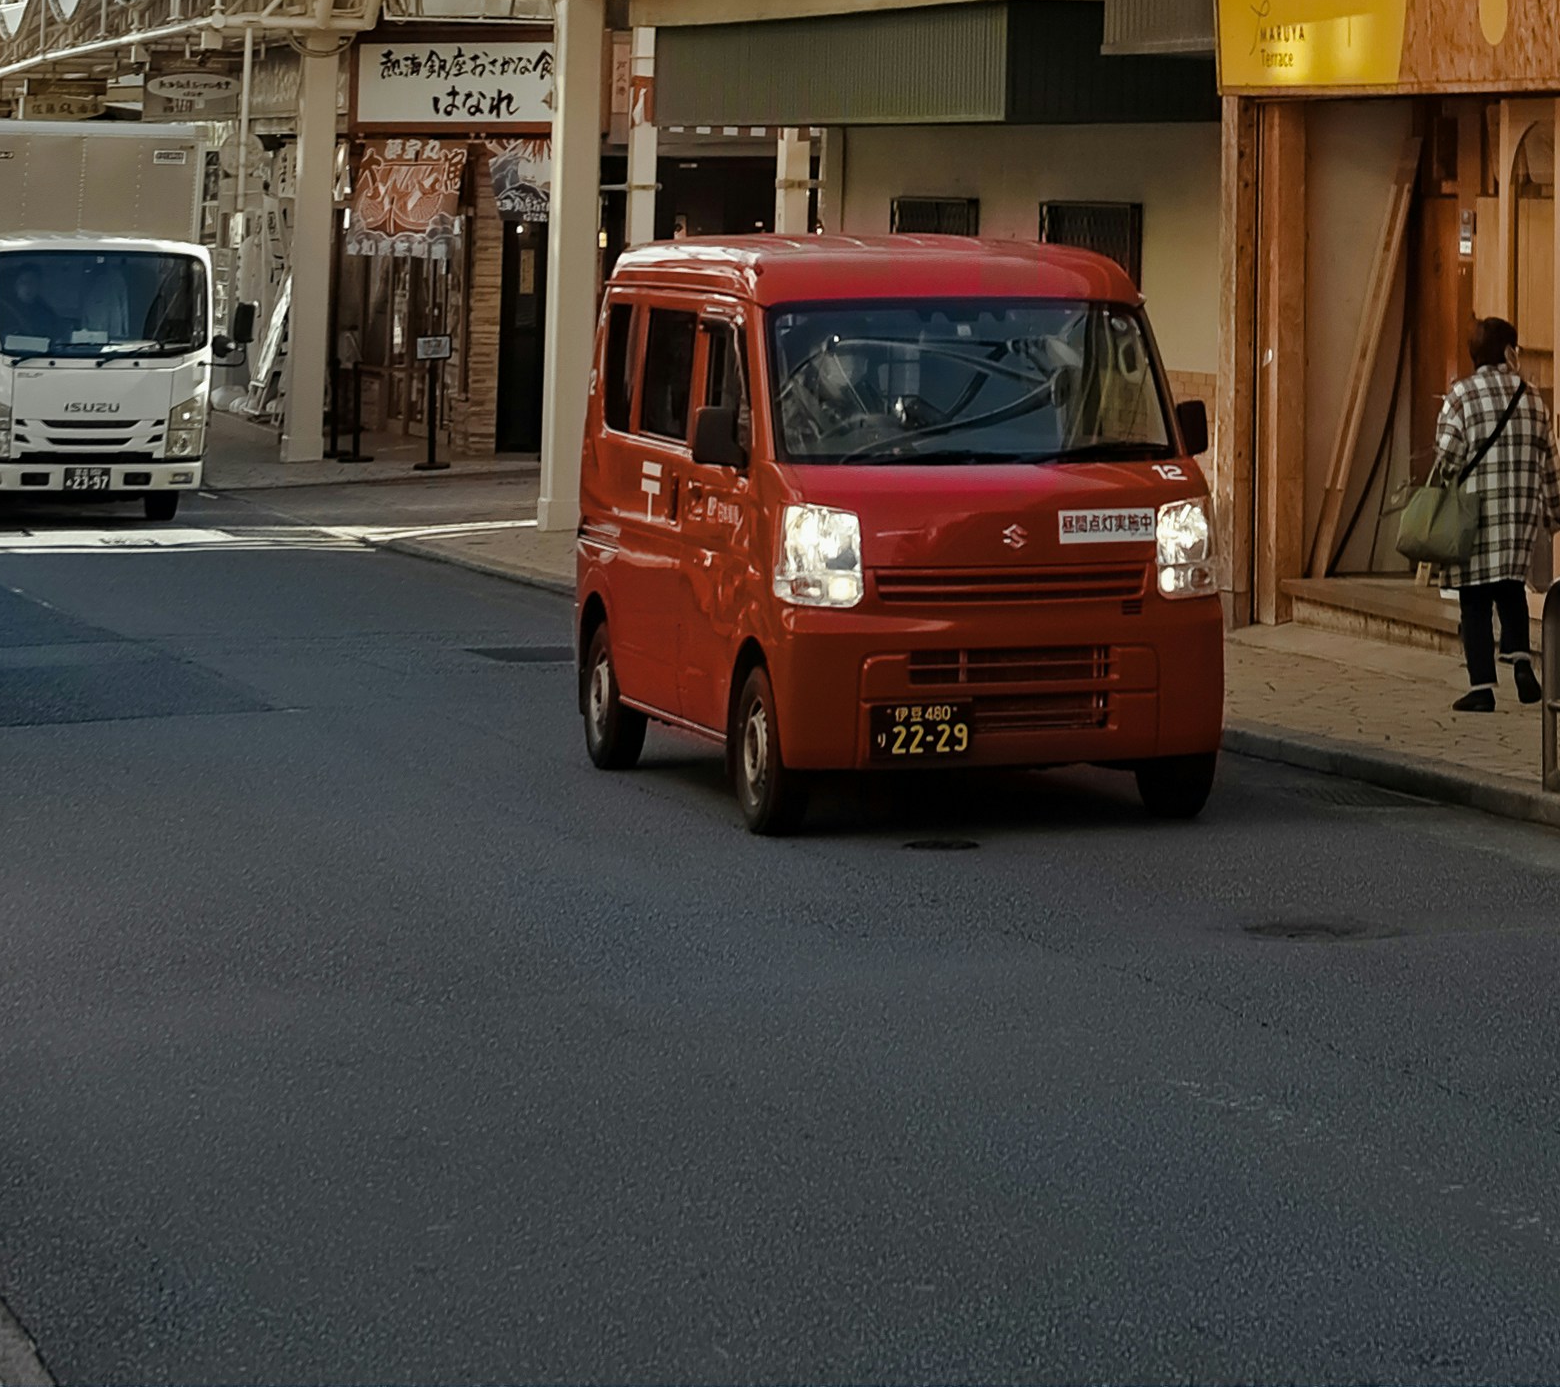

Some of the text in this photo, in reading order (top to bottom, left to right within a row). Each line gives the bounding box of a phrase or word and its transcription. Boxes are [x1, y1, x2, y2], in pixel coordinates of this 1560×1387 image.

[1260, 25, 1304, 42] MARUYA
[1261, 49, 1293, 68] Terrace
[432, 85, 520, 119] はなれ
[64, 403, 120, 413] ISUZU
[1152, 465, 1188, 480] 12
[1062, 513, 1153, 534] 昼間点灯実施中
[895, 705, 951, 722] 伊豆 480
[892, 723, 968, 754] 22-29
